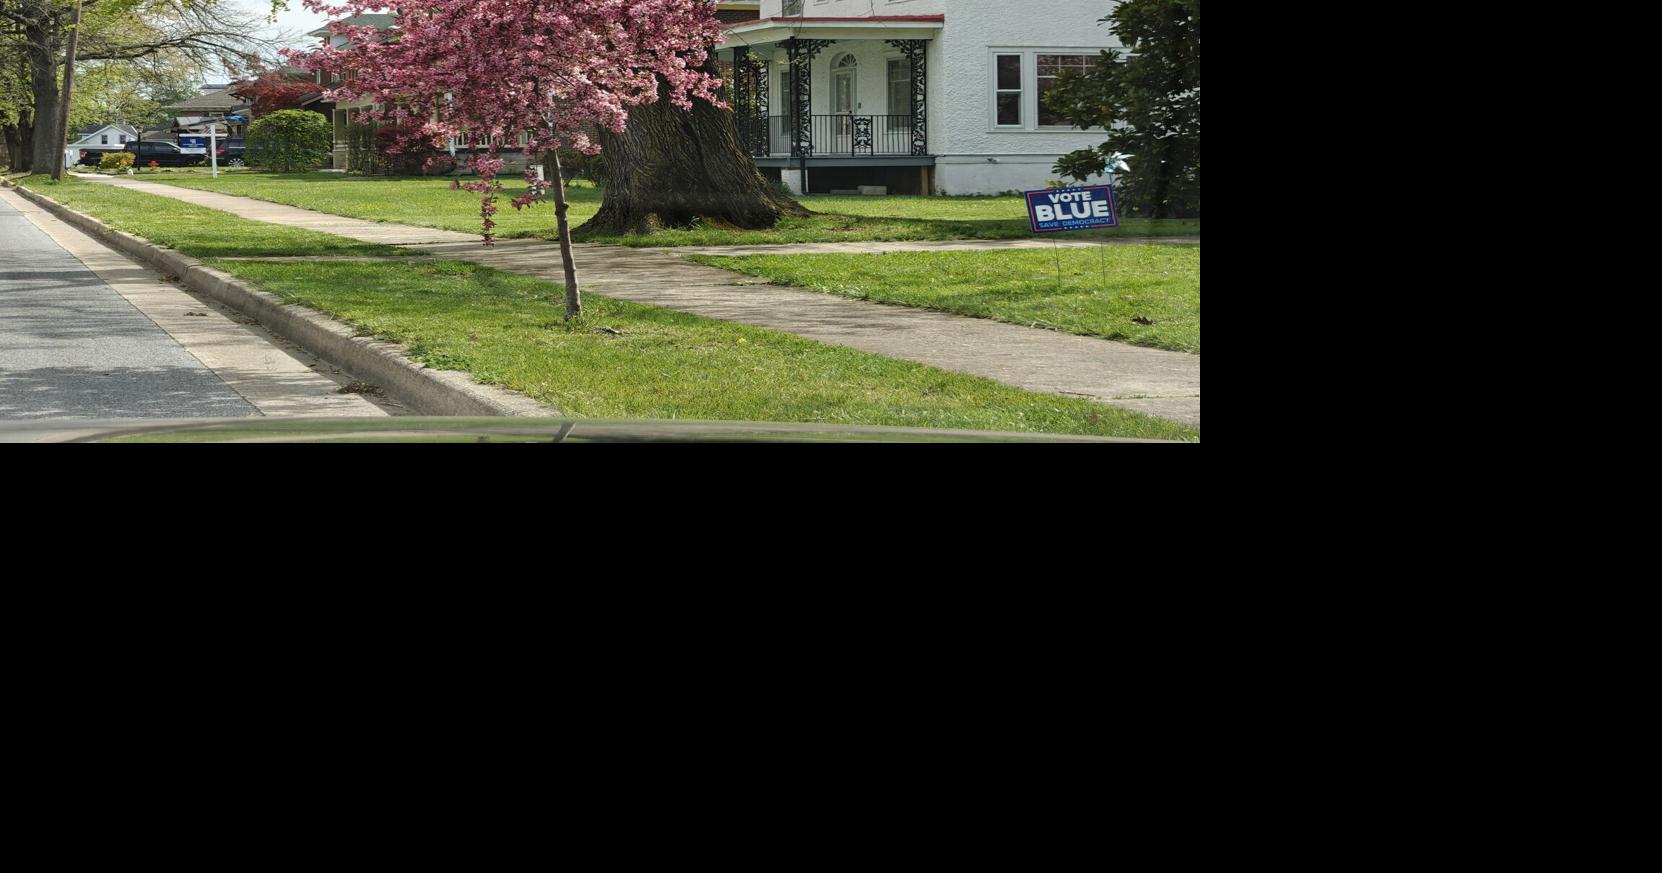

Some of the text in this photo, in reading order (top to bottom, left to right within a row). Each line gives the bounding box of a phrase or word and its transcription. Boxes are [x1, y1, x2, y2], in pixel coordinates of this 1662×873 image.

[1048, 191, 1092, 203] VOTE
[1035, 200, 1109, 222] BLUE
[1062, 218, 1109, 226] DEMOCRACY
